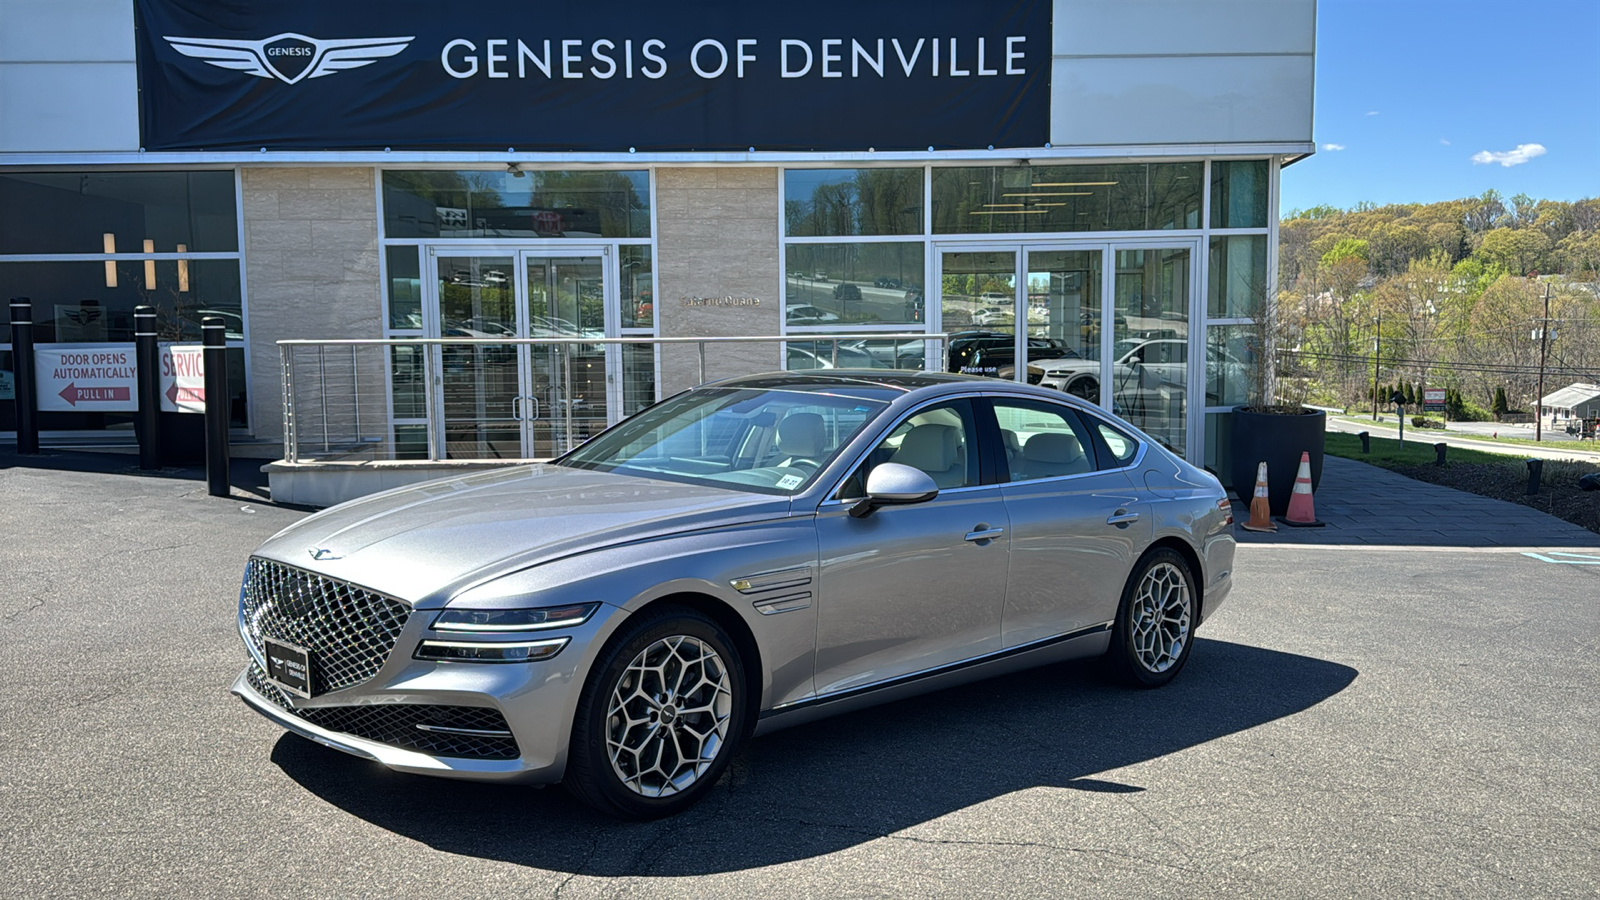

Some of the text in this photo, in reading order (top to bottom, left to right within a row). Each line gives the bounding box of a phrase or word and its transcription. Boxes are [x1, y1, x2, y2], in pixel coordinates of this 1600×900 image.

[267, 47, 312, 56] GENESIS
[441, 36, 1026, 79] GENESIS OF DENVILLE
[61, 353, 127, 366] DOOR OPENS
[162, 352, 204, 377] SERVIC
[53, 367, 136, 379] AUTOMATICALLY
[77, 389, 114, 399] PULL IN
